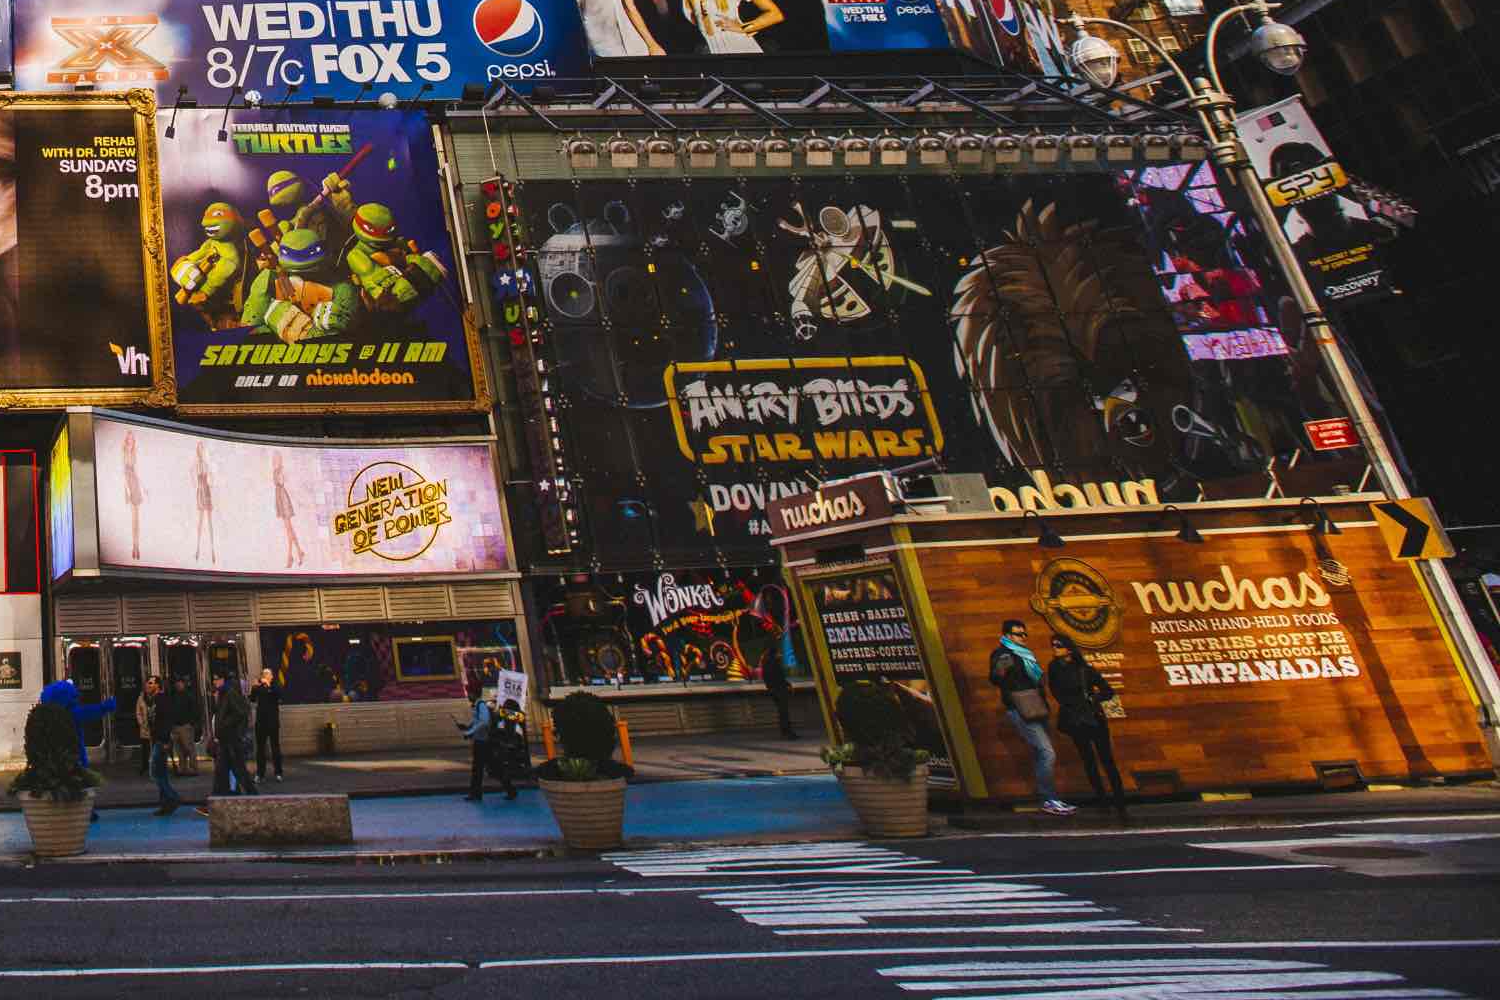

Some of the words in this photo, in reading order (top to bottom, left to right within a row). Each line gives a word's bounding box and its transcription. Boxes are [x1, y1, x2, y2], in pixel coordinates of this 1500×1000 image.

[312, 42, 411, 84] FOX
[415, 42, 451, 81] 5
[486, 59, 552, 81] pepsi
[42, 148, 73, 158] WITH
[76, 148, 97, 157] DR.
[100, 147, 136, 157] DREW
[94, 136, 135, 146] REHAB
[232, 133, 351, 153] TURTLES
[59, 159, 137, 173] SUNDAYS
[85, 175, 139, 202] 8pm
[1278, 167, 1336, 201] SPY
[1325, 275, 1380, 296] Discovery
[199, 344, 353, 366] SATURDAYS
[404, 342, 447, 362] AM
[235, 375, 273, 388] ONLY
[278, 375, 299, 388] ON
[306, 368, 414, 387] nickelodeon
[681, 380, 799, 432] ANGRY
[803, 378, 915, 425] BIRDS
[702, 434, 813, 464] STAR
[814, 429, 925, 458] WARS
[335, 479, 448, 534] GENERATION
[780, 490, 865, 530] nuchas
[353, 525, 380, 552] OF
[384, 502, 452, 539] POWER
[633, 573, 724, 626] WONKA
[1130, 565, 1330, 614] nuchas
[822, 611, 860, 624] FRESH
[867, 607, 905, 620] BAKED
[1151, 619, 1207, 634] ARTISAN
[1211, 615, 1290, 630] HAND-HELD
[1295, 613, 1339, 627] FOODS
[826, 625, 912, 644] EMPANADAS
[1154, 635, 1256, 653] PASTRIES
[1264, 631, 1346, 647] COFFEE
[1160, 652, 1221, 664] SWEETS
[1230, 649, 1259, 659] HOT
[1262, 645, 1351, 659] CHOCOLATE
[1164, 657, 1360, 685] EMPANADAS
